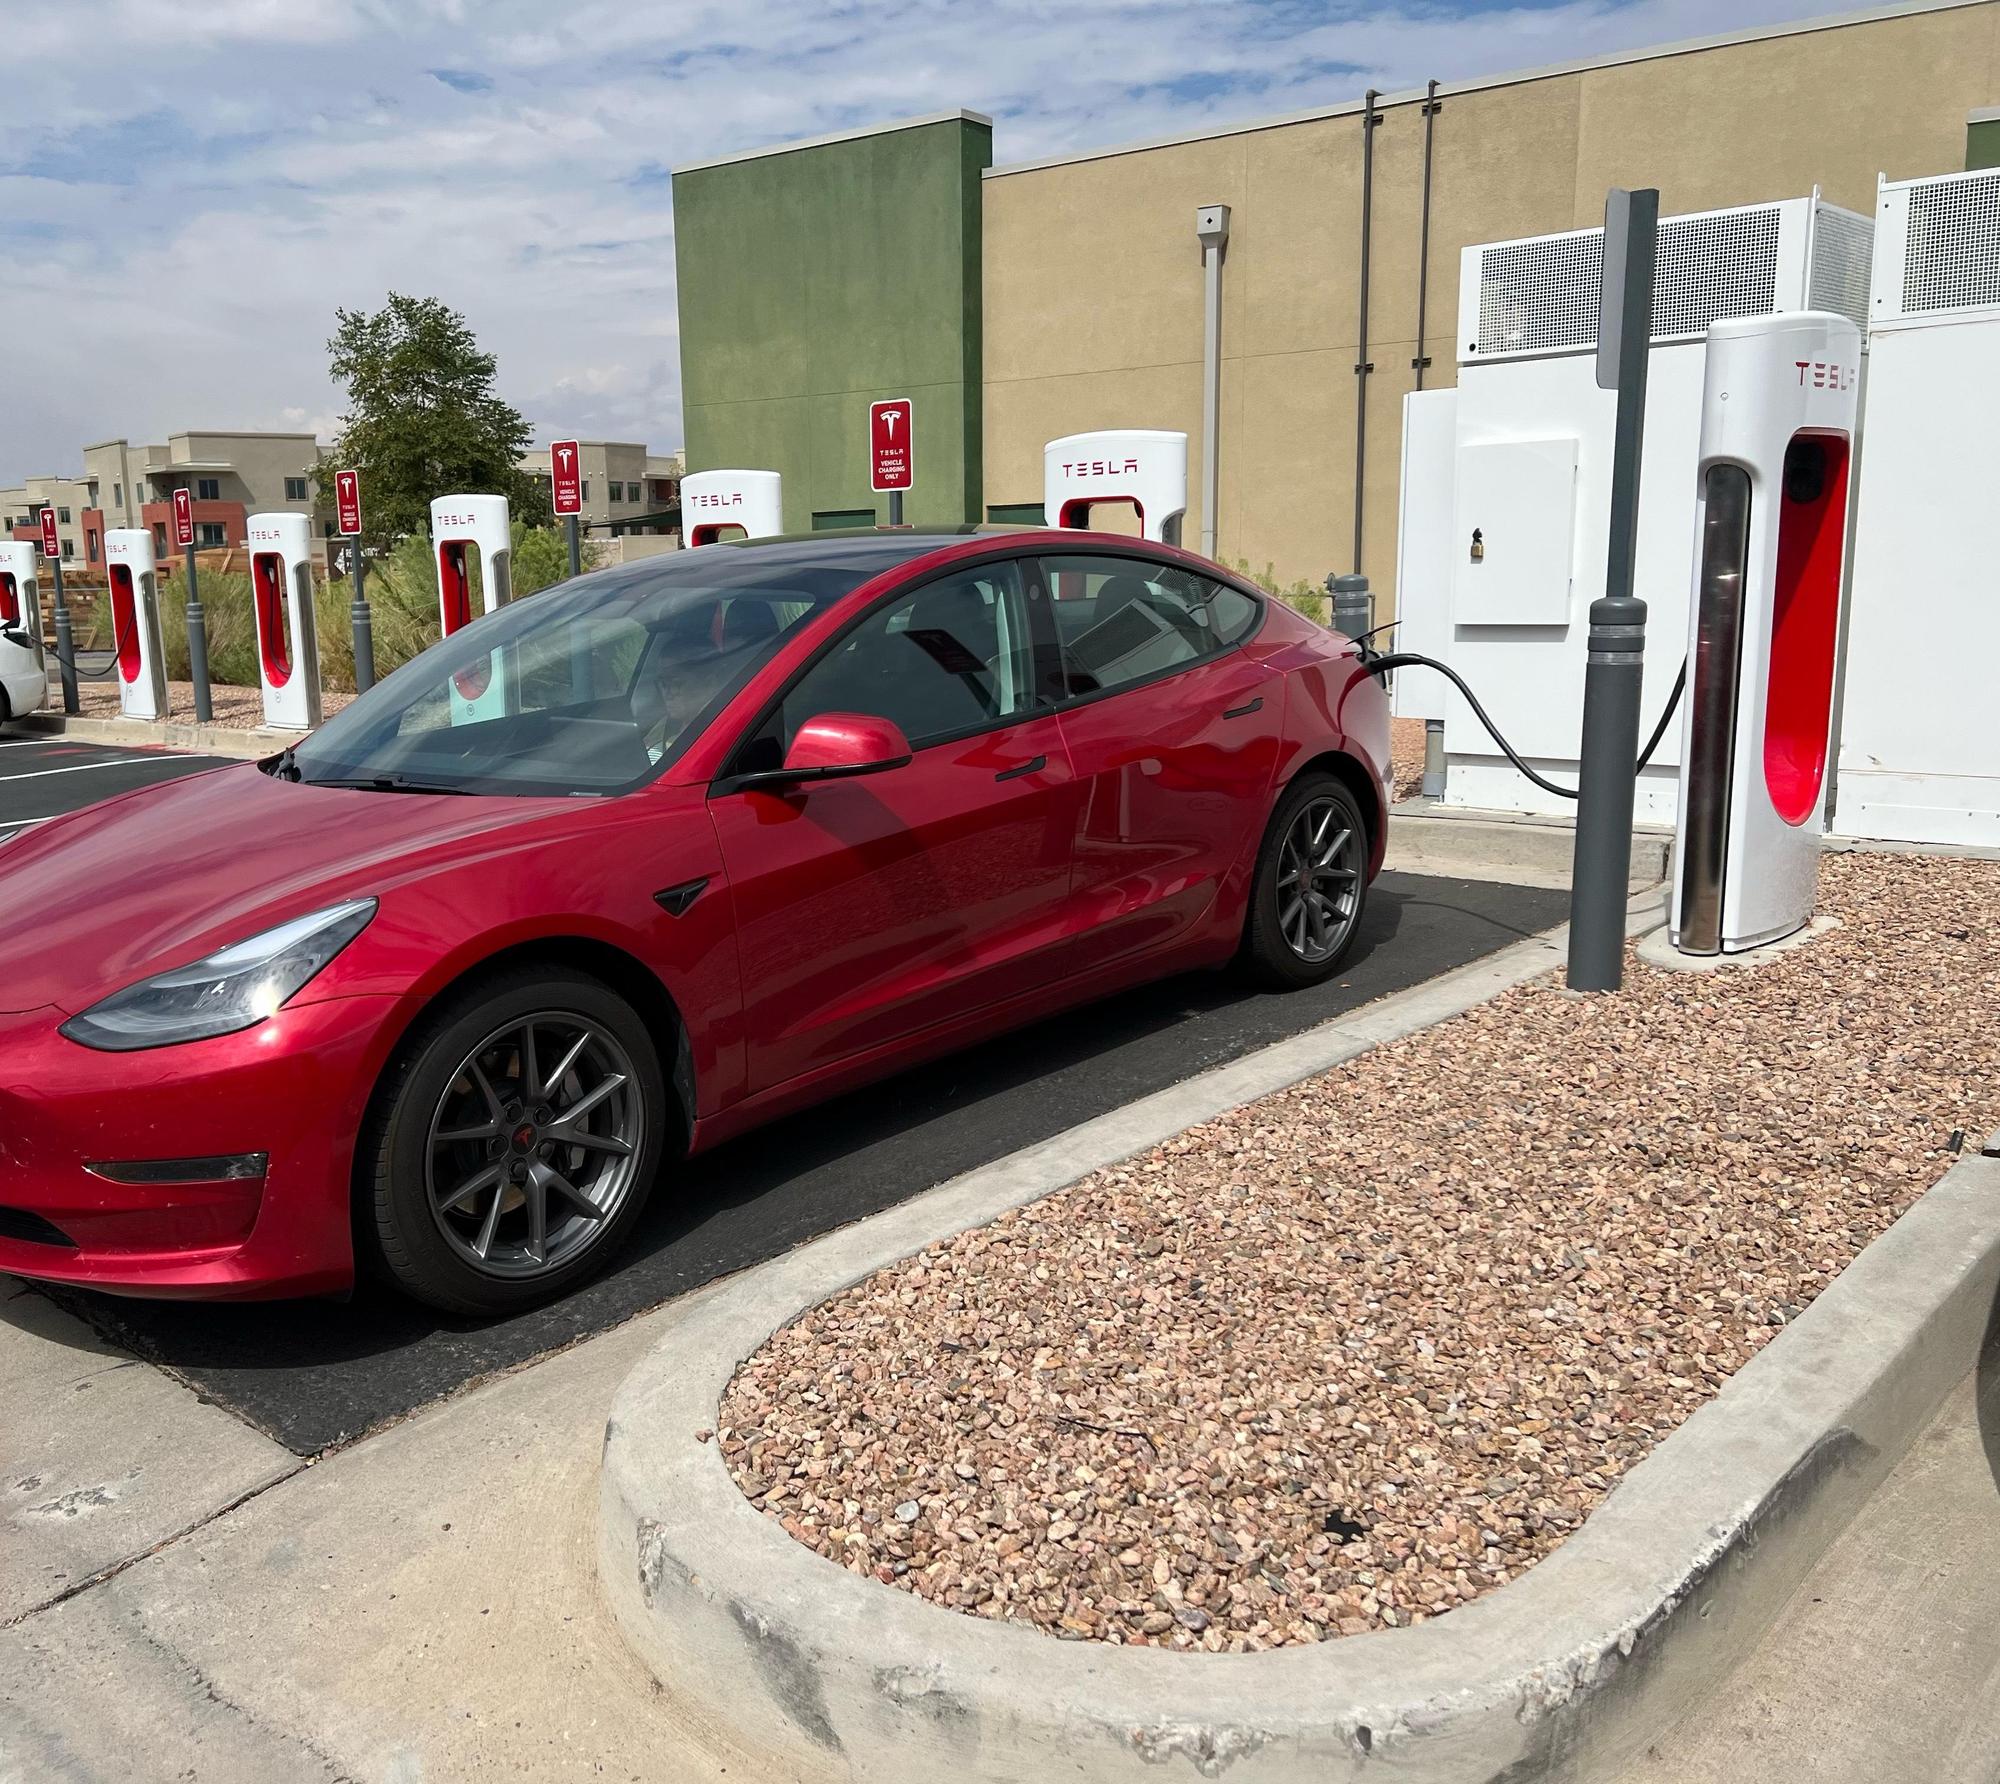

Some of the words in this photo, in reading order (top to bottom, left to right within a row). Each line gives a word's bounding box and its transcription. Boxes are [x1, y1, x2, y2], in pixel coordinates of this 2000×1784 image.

[880, 448, 904, 456] TESLA
[880, 458, 903, 467] VEHICLE
[878, 465, 906, 474] CHARGING
[1062, 459, 1138, 478] TESLA
[691, 493, 742, 507] TESLA
[437, 514, 476, 525] TESLA
[250, 530, 280, 540] TESLA
